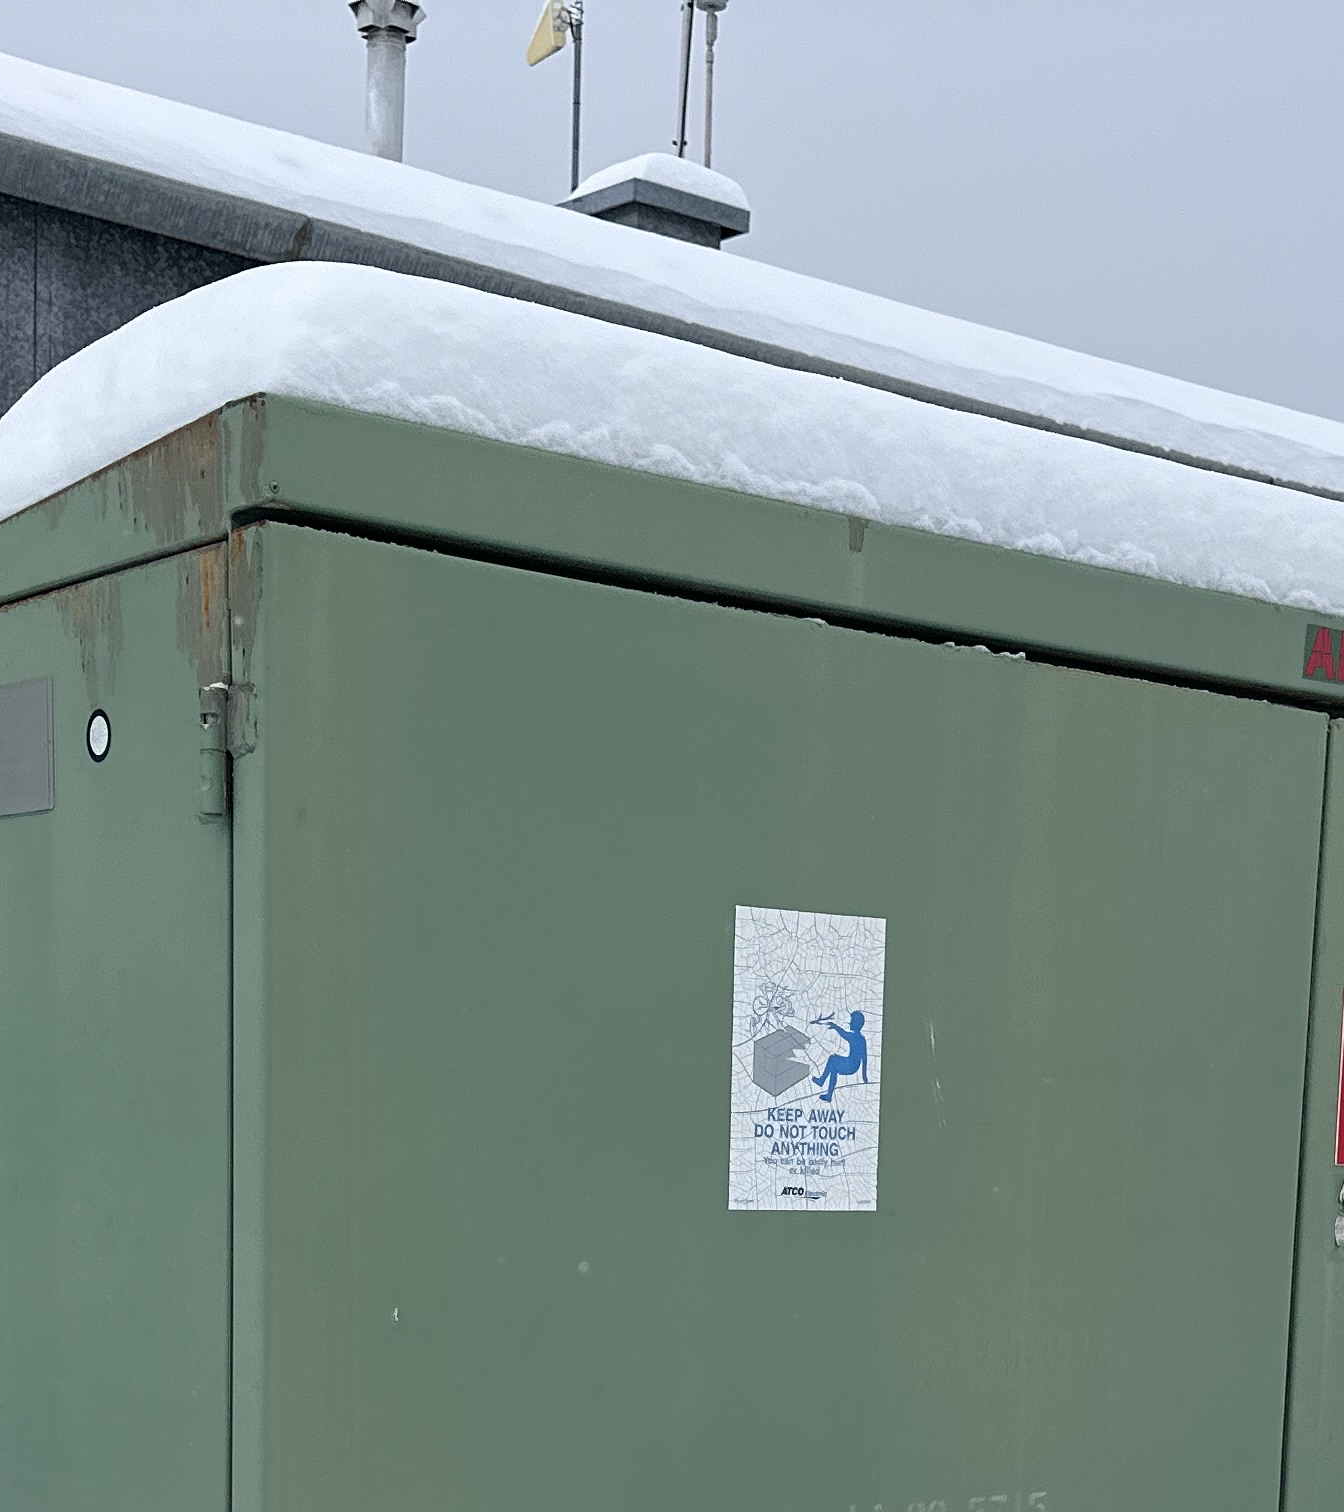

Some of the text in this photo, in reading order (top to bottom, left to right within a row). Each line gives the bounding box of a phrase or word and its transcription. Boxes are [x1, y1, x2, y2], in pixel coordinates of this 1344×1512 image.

[767, 1107, 845, 1123] KEEP AWAY
[754, 1124, 856, 1141] DO NOT TOUCH
[771, 1141, 839, 1156] ANYTHING
[781, 1186, 805, 1196] ATCO
